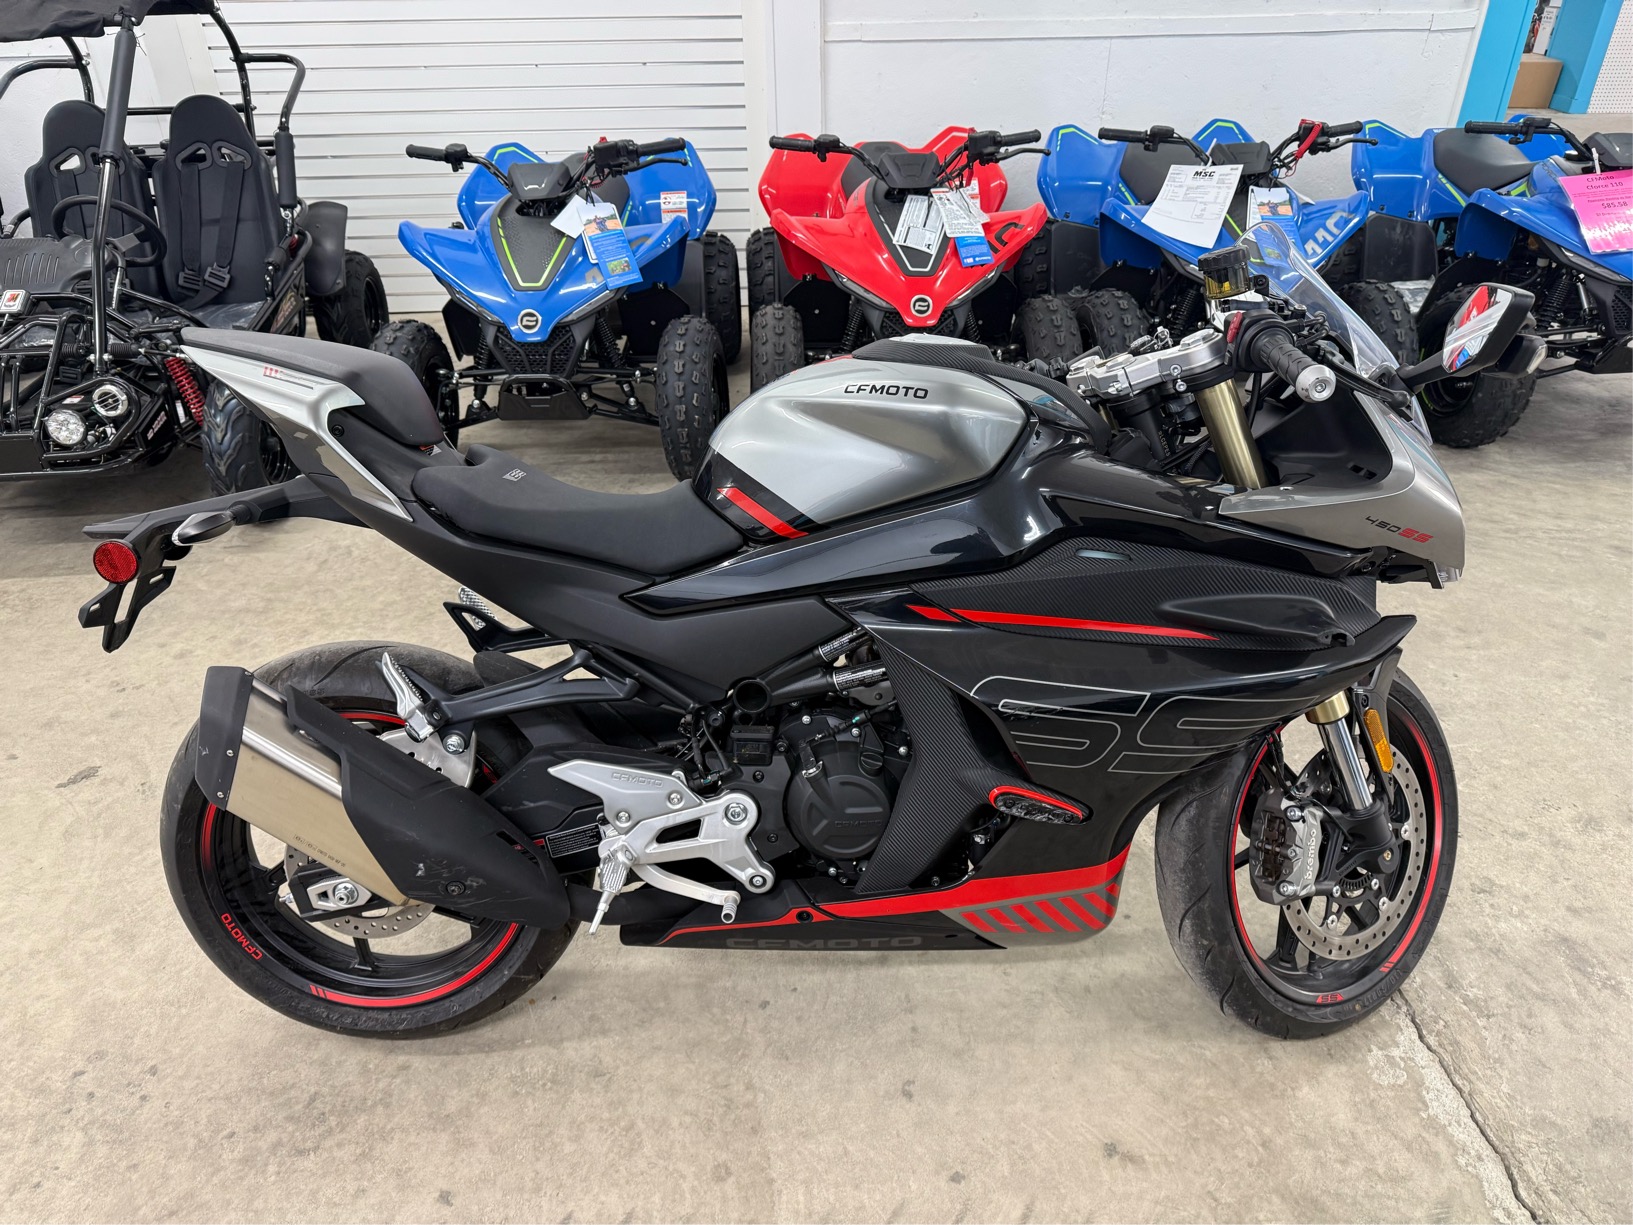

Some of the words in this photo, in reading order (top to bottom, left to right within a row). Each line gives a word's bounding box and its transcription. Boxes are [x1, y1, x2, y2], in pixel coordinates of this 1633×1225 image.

[1193, 170, 1216, 178] MSC
[844, 384, 929, 400] CFMOTO
[612, 772, 664, 788] CFMOTO
[1304, 828, 1317, 880] brembo
[221, 913, 263, 960] CFMOTO
[726, 936, 922, 949] CFMOTO
